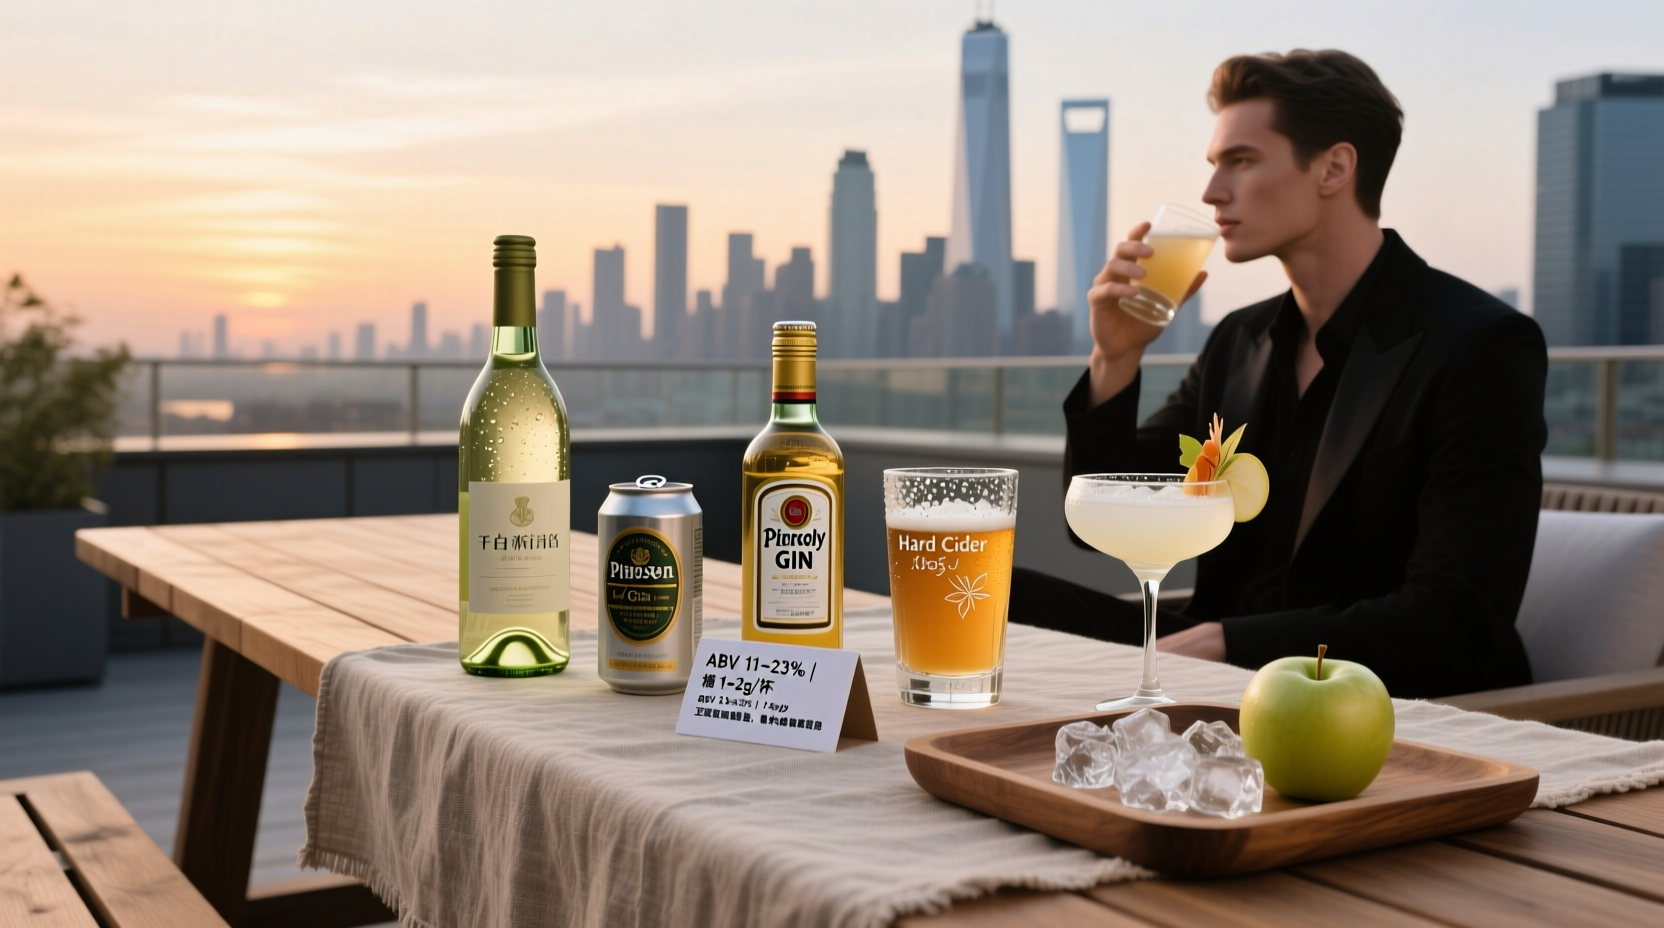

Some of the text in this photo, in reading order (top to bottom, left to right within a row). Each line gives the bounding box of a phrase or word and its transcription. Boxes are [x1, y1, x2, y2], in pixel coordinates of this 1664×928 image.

[899, 535, 988, 552] Hard Cider
[775, 550, 813, 570] GIN
[706, 653, 740, 670] ABV
[745, 656, 806, 677] 11-23%
